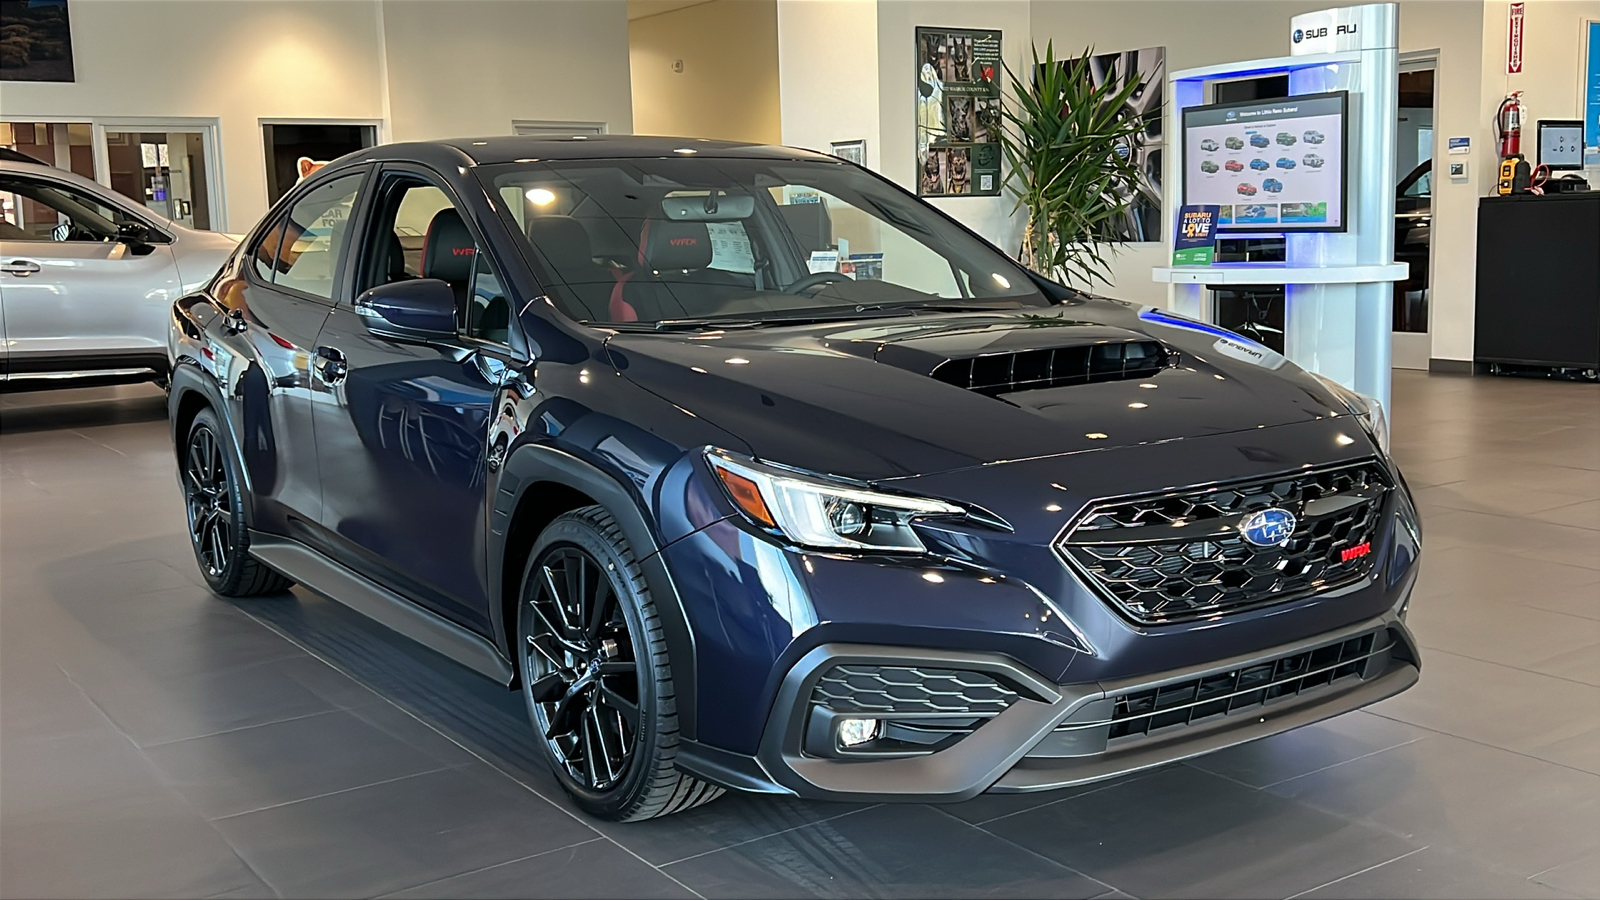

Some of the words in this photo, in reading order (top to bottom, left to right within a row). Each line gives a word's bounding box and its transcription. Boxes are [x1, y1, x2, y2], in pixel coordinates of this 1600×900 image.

[1305, 24, 1357, 39] SUBRU
[670, 238, 697, 246] WRX
[452, 248, 474, 256] WR
[1341, 541, 1371, 562] WRX
